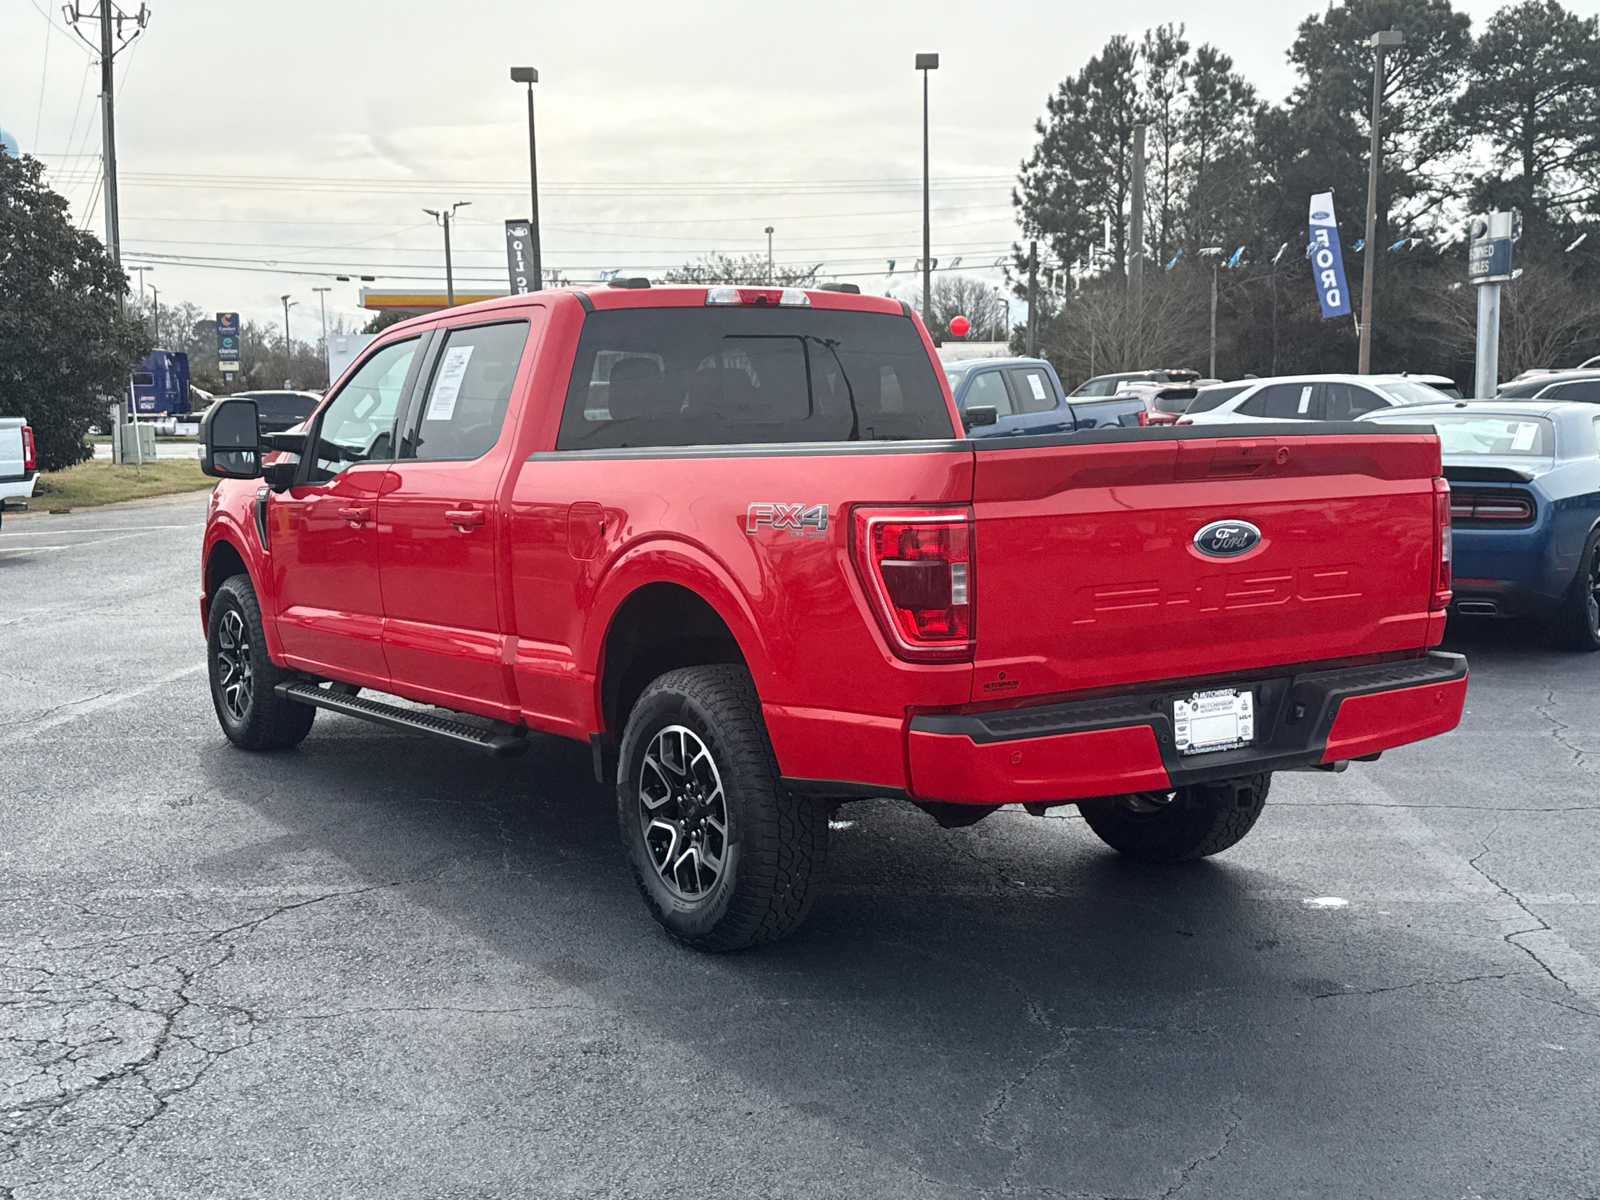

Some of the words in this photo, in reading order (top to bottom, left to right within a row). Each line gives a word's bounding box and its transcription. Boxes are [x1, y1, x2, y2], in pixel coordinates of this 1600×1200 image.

[746, 502, 829, 535] FX4
[1211, 527, 1248, 550] Ford
[1072, 562, 1364, 624] F-150
